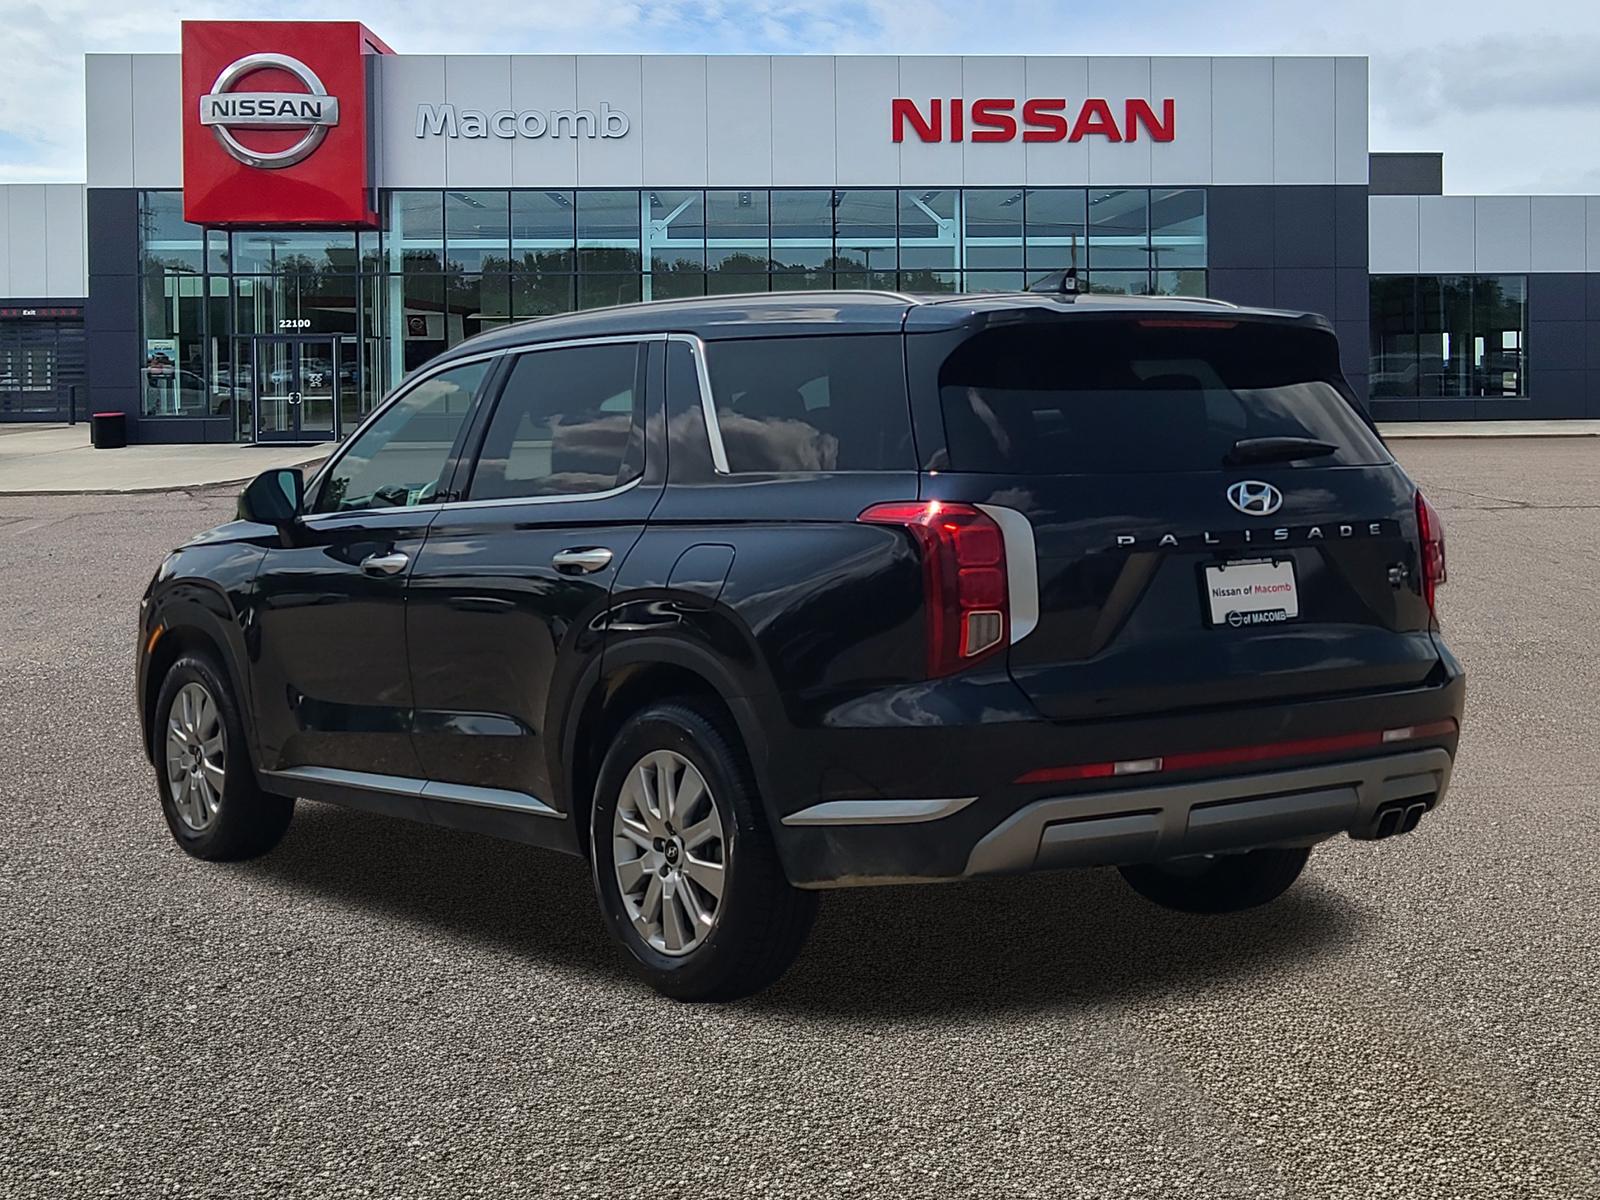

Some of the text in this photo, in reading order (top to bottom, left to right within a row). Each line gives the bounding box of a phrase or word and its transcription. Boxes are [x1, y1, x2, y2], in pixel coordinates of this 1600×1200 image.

[212, 100, 322, 117] NISSAN
[415, 101, 630, 139] Macomb
[892, 98, 1175, 143] NISSAN
[279, 319, 311, 328] 22100
[1117, 523, 1381, 547] PALISADE
[1212, 583, 1292, 598] Nissan of Macomb
[1243, 611, 1287, 624] of MACOMB
